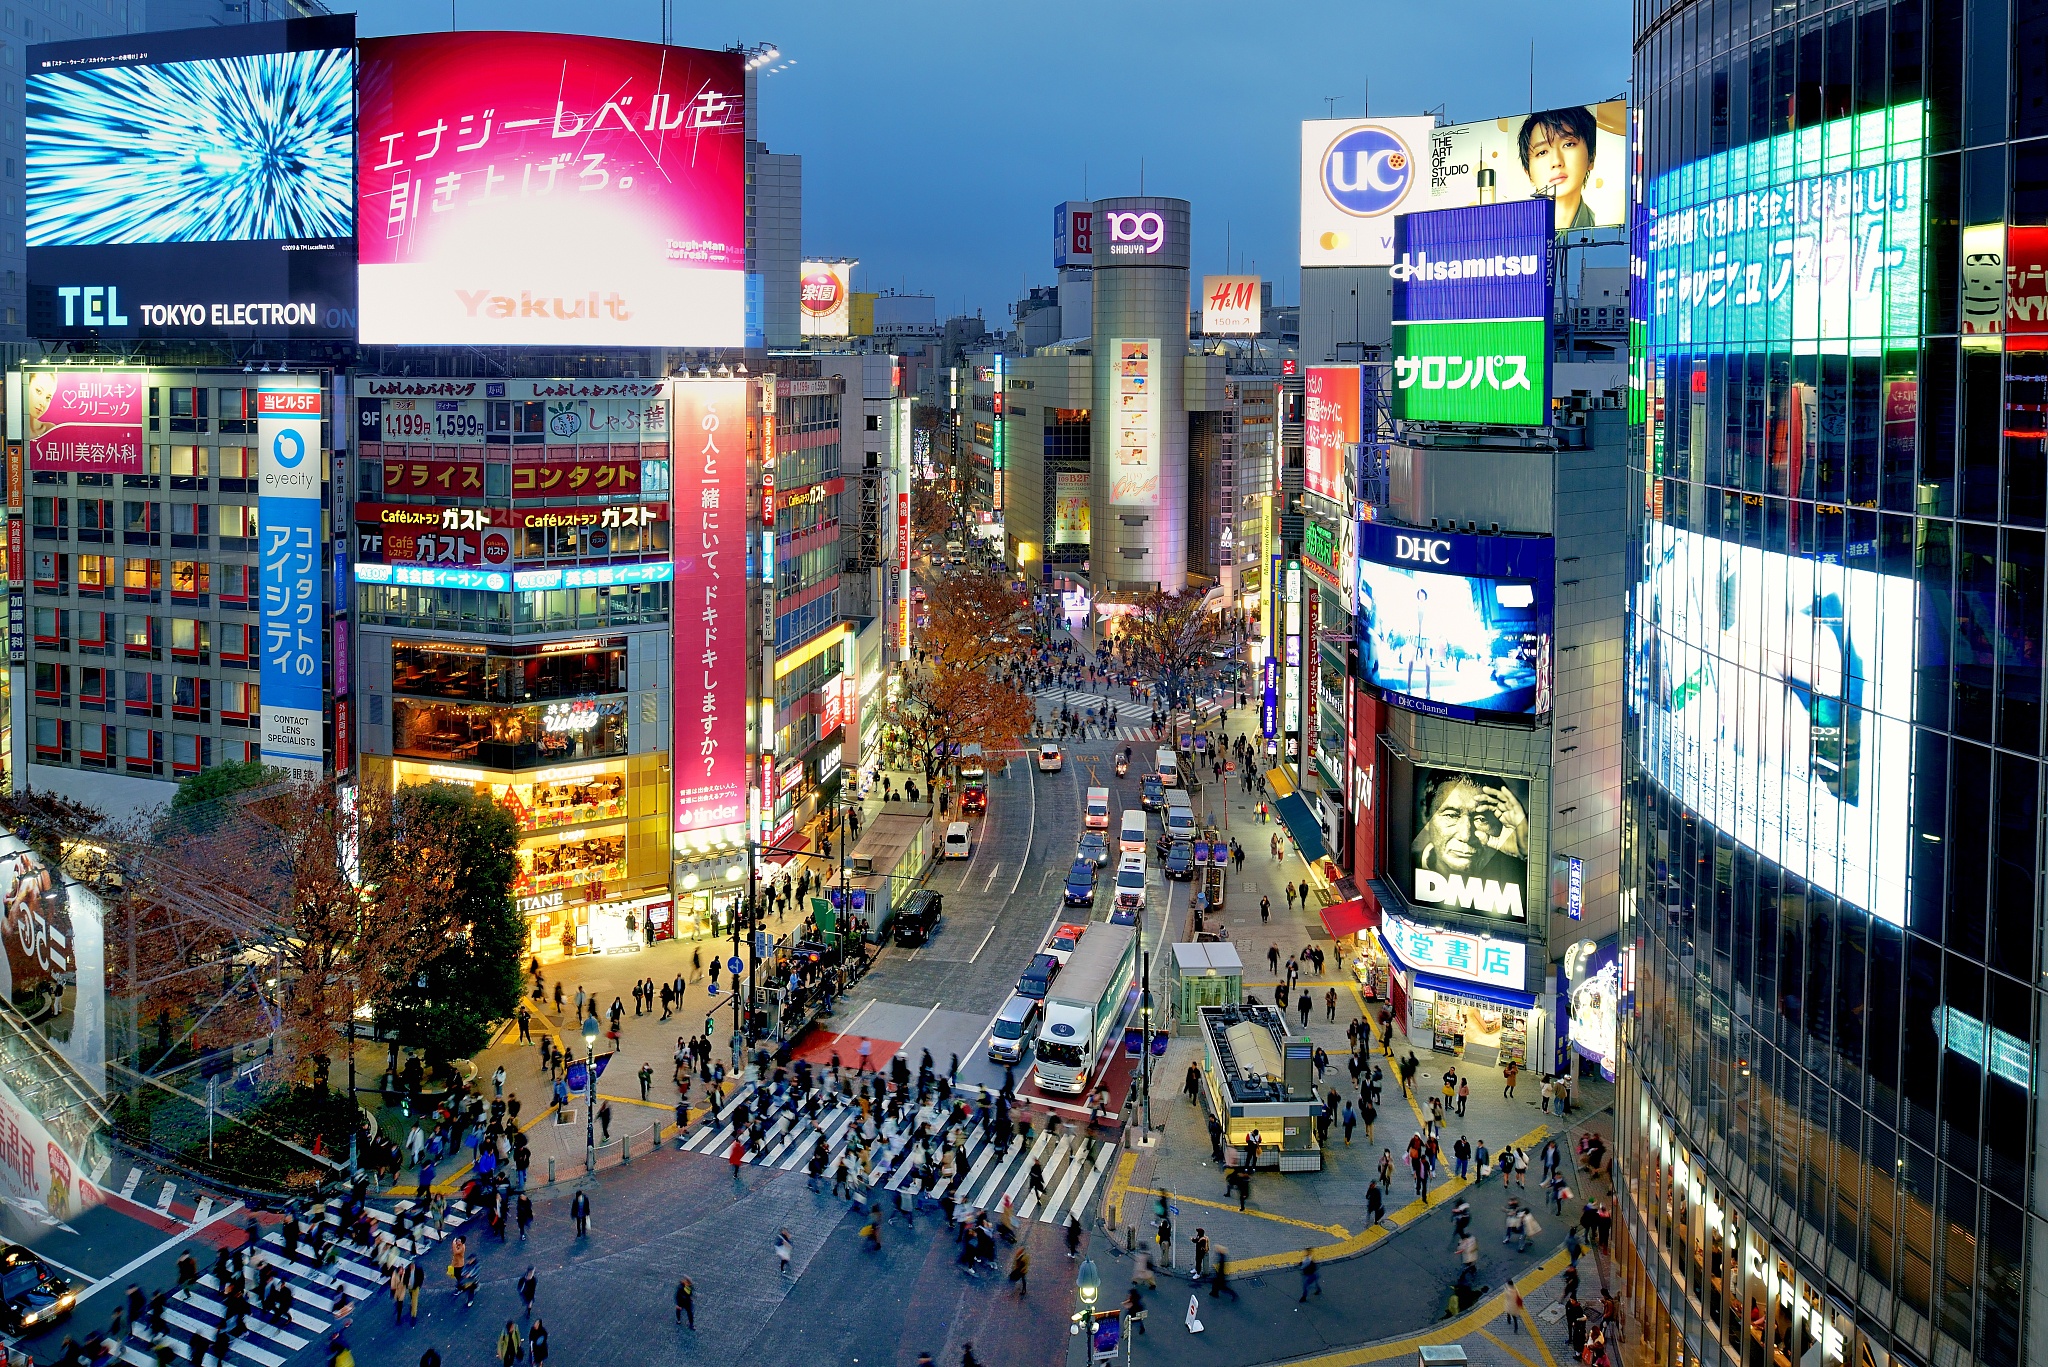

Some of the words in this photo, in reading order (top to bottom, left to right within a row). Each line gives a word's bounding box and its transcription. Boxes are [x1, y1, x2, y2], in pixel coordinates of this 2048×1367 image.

[1432, 136, 1452, 148] THE
[1432, 146, 1453, 159] ART
[1432, 157, 1446, 168] OF
[1432, 164, 1469, 178] STUDIO
[1432, 177, 1447, 188] FIX
[1107, 212, 1164, 254] 109
[666, 239, 725, 251] Tough-Man
[666, 248, 708, 260] Refresh
[1110, 244, 1144, 255] SHIBUYA
[1389, 251, 1538, 282] Hisamitsu
[1545, 238, 1553, 287] サロンパス
[801, 283, 837, 301] 楽園
[1210, 282, 1255, 312] H&M
[58, 286, 128, 326] TEL
[140, 304, 206, 326] TOKYO
[211, 303, 316, 325] ELECTRON
[455, 289, 634, 322] Yakult
[1394, 354, 1531, 391] サロンパス
[78, 382, 137, 399] 品川スキン
[368, 381, 477, 396] しゃぶしゃぶバイキング
[532, 383, 665, 397] しゃぶしゃぶバイキング
[78, 401, 130, 417] クリニック
[264, 394, 314, 410] 当ビル5F
[361, 411, 380, 426] 9F
[589, 404, 665, 431] しゃぶ葉
[45, 442, 137, 465] 品川美容外科
[265, 471, 314, 490] eyecity
[385, 463, 482, 490] プライス
[513, 463, 638, 490] コンタクト
[1069, 475, 1090, 483] B2F
[601, 506, 657, 528] ガスト
[764, 495, 773, 521] ガスト
[442, 507, 492, 531] ガスト
[11, 520, 21, 553] 外貨両替
[361, 534, 382, 552] 7F
[388, 535, 413, 549] Café
[388, 549, 413, 558] レストラン
[416, 533, 476, 563] ガスト
[487, 546, 507, 556] ガスト
[1396, 535, 1450, 565] DHC
[359, 566, 388, 581] AEON
[396, 567, 484, 587] 英会話イーオン
[518, 573, 556, 588] AEON
[565, 565, 671, 587] 英会話イーオン
[266, 525, 293, 675] アイシティ
[295, 526, 315, 677] コンタクトの
[10, 595, 23, 648] 加藤眼科
[1398, 696, 1415, 708] DHC
[1415, 699, 1448, 715] Channel
[274, 714, 309, 727] CONTACT
[281, 725, 301, 735] LENS
[267, 733, 316, 747] SPECIALISTS
[821, 743, 842, 777] LUSH
[680, 782, 738, 796] 普通は出会えない人と、
[680, 790, 738, 805] 普通に出会えるアプリ。
[693, 804, 739, 823] tinder
[1415, 867, 1524, 918] DMM
